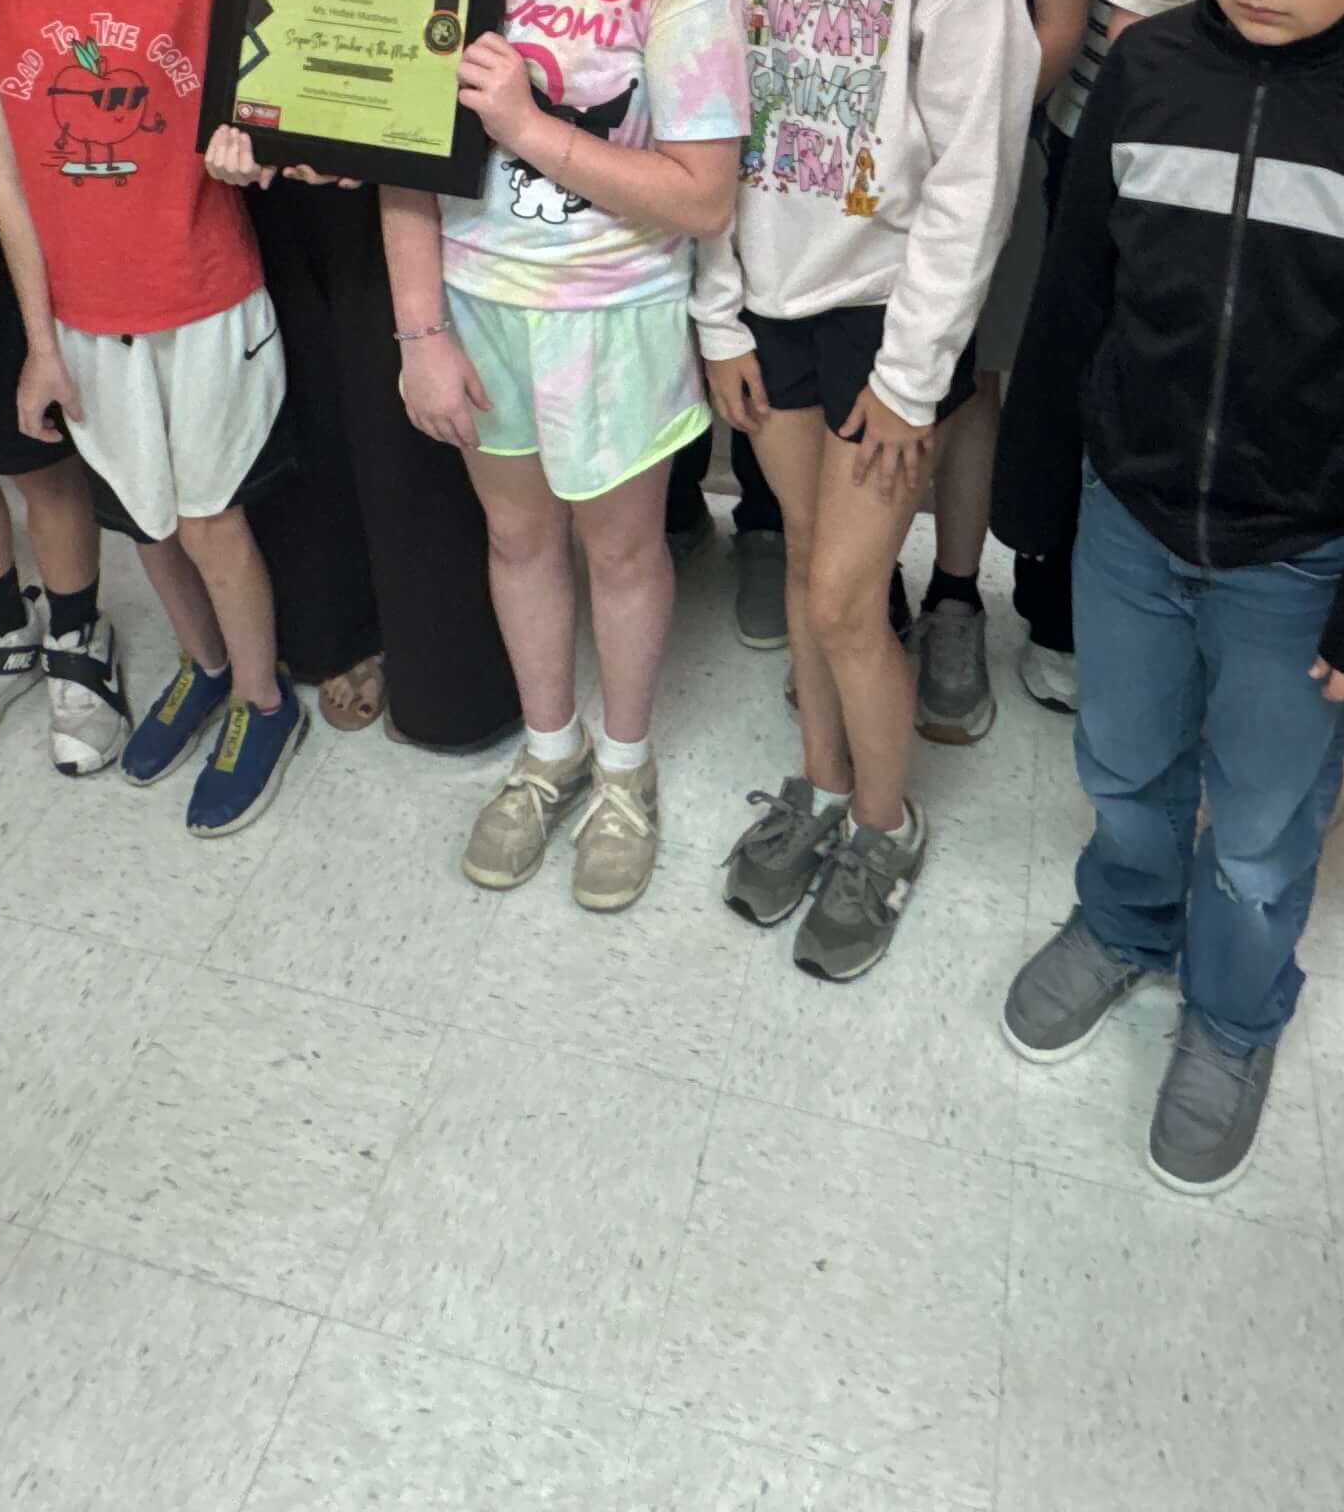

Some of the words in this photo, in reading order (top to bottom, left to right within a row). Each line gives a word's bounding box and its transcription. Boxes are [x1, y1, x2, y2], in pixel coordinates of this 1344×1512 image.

[0, 48, 44, 101] RAD
[40, 19, 80, 55] TO
[90, 11, 141, 52] THE
[146, 33, 200, 98] CORE
